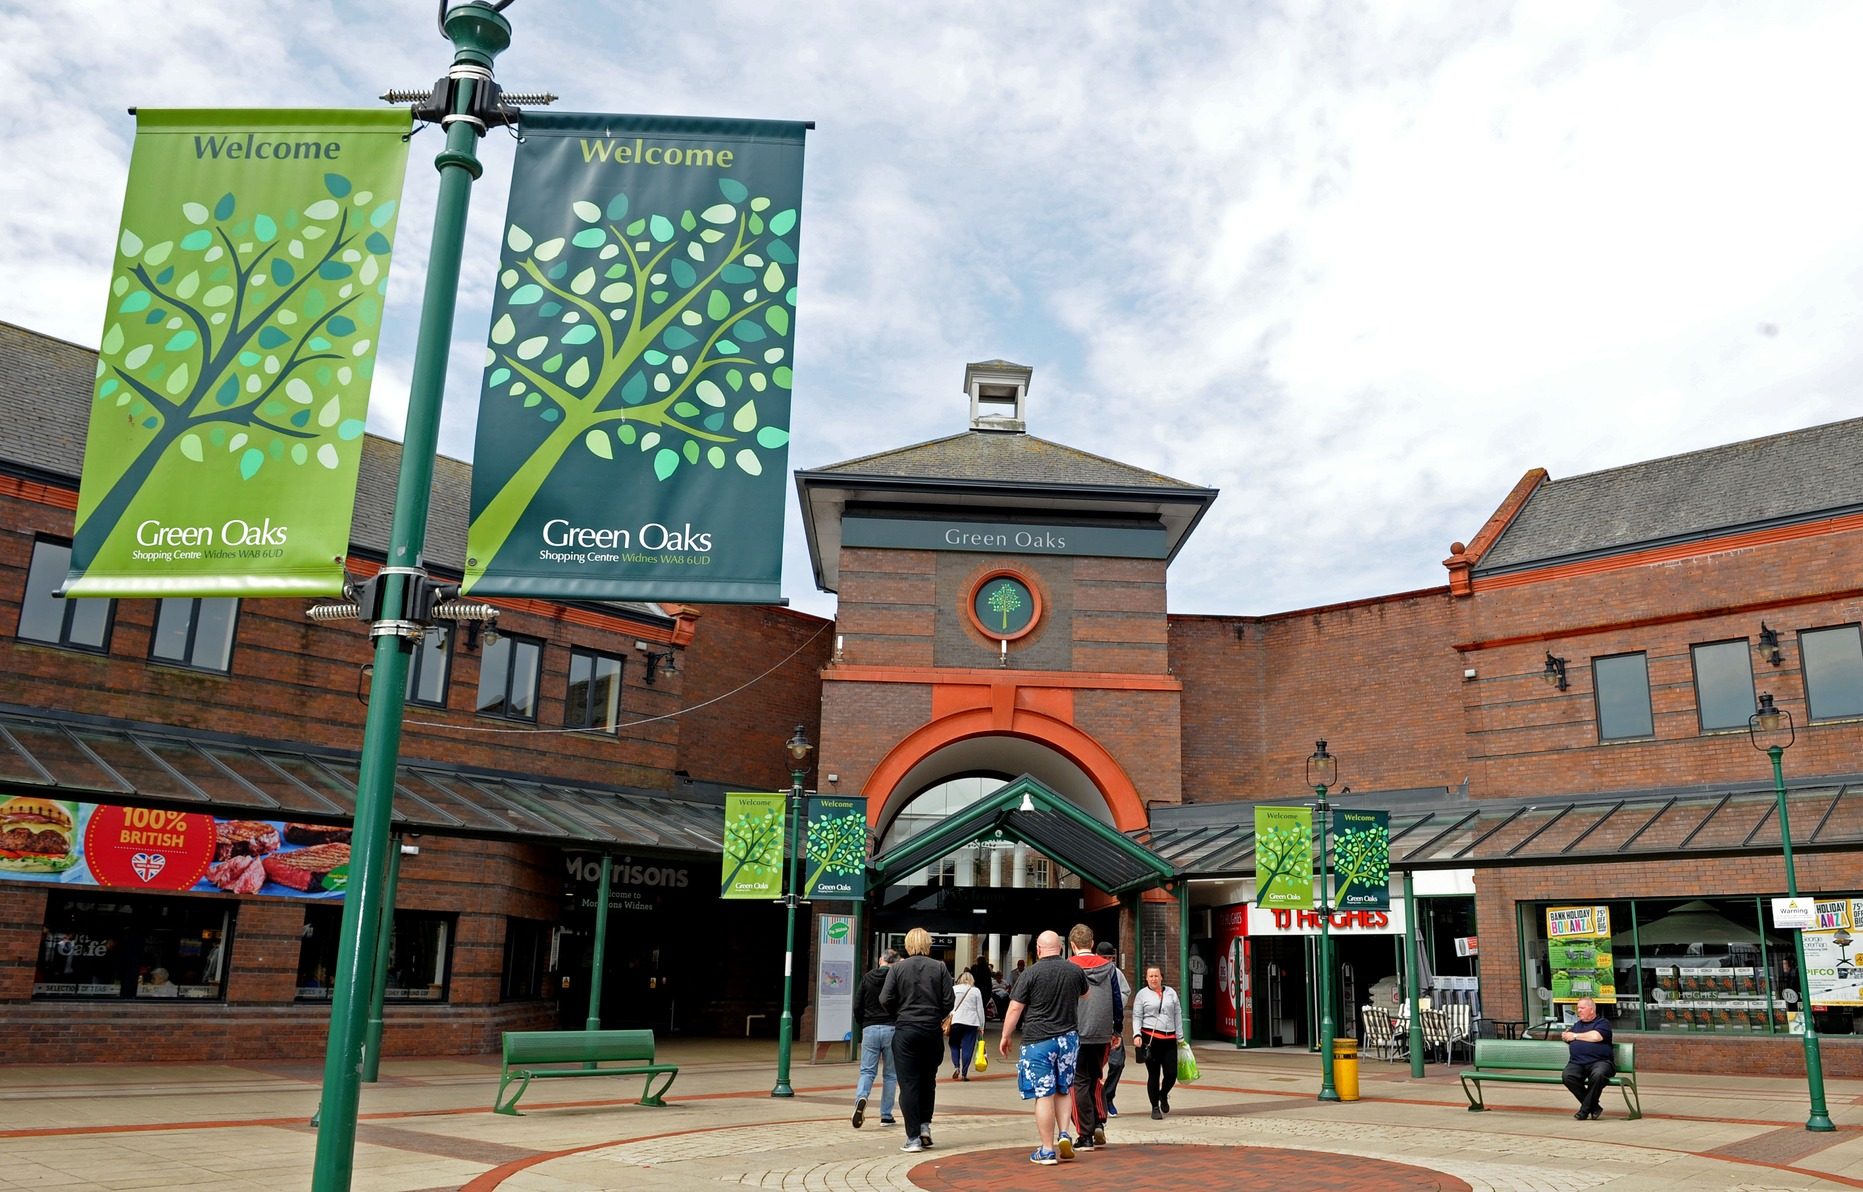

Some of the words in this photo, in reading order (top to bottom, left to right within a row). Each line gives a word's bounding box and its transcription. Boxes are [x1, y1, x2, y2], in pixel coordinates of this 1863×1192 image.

[194, 134, 341, 160] Welcome
[579, 138, 735, 168] Welcome
[136, 520, 213, 546] Green
[221, 517, 288, 546] Oaks
[542, 519, 631, 549] Green
[639, 523, 713, 552] Oaks
[945, 529, 1007, 547] Green
[1015, 531, 1066, 549] Oaks
[132, 550, 172, 562] Shopping
[173, 550, 202, 560] Centre
[204, 549, 237, 560] Widnes
[239, 550, 261, 559] WA8
[262, 549, 284, 559] 6UD
[539, 550, 586, 564] Shopping
[587, 552, 620, 563] Centre
[621, 553, 657, 564] Widnes
[660, 554, 684, 565] WA8
[686, 555, 711, 566] 6UD
[739, 799, 773, 807] Welcome
[821, 800, 854, 809] Welcome
[122, 807, 188, 832] 100%
[1267, 812, 1299, 820] Welcome
[1344, 813, 1377, 823] Welcome
[119, 830, 185, 848] BRITISH
[566, 856, 689, 888] Morisons
[735, 882, 753, 890] Green
[754, 882, 769, 890] Oaks
[817, 883, 835, 892] Green
[836, 883, 851, 892] Oaks
[596, 889, 632, 899] lcome
[1269, 893, 1286, 901] Green
[1287, 893, 1302, 901] Oaks
[1347, 894, 1364, 903] Green
[1365, 895, 1379, 903] Oaks
[582, 898, 622, 910] Morons
[624, 900, 653, 911] Widnes
[1816, 902, 1845, 914] HOLIDAY
[1271, 909, 1291, 929] TJ
[1550, 912, 1566, 921] BANK
[1566, 909, 1591, 919] HOLIDAY
[1816, 912, 1849, 929] ANZA
[1551, 918, 1592, 934] BONANZA
[57, 939, 107, 957] Café
[1679, 991, 1718, 1000] HUGHES
